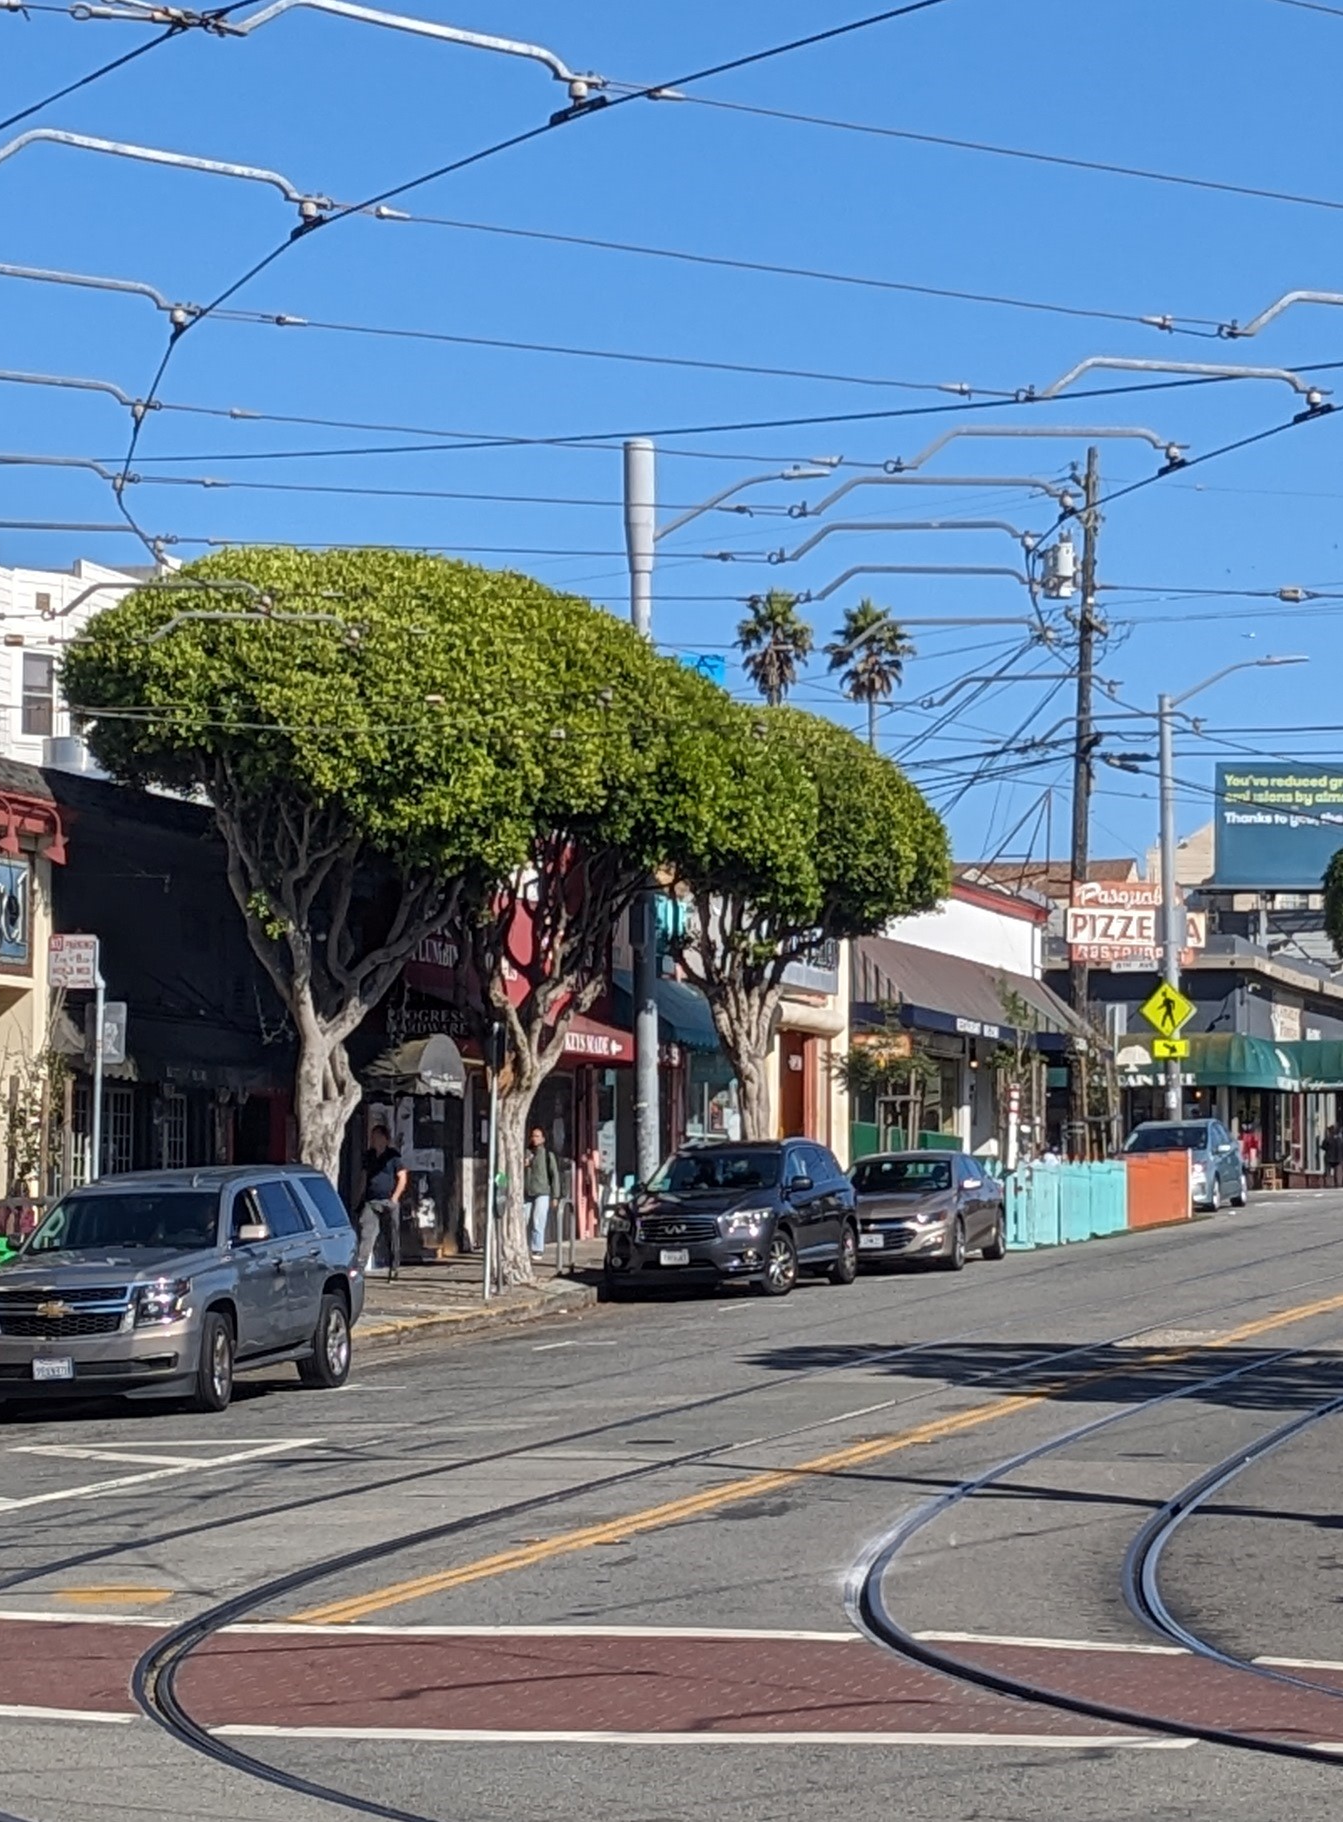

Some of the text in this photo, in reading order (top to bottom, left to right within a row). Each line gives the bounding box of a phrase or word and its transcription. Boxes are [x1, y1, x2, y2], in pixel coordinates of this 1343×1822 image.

[1224, 774, 1269, 788] You've
[1270, 775, 1328, 788] reduced
[1295, 791, 1313, 806] by
[1224, 811, 1273, 825] Thanks
[1274, 812, 1288, 825] to
[1070, 912, 1202, 944] PIZZEA
